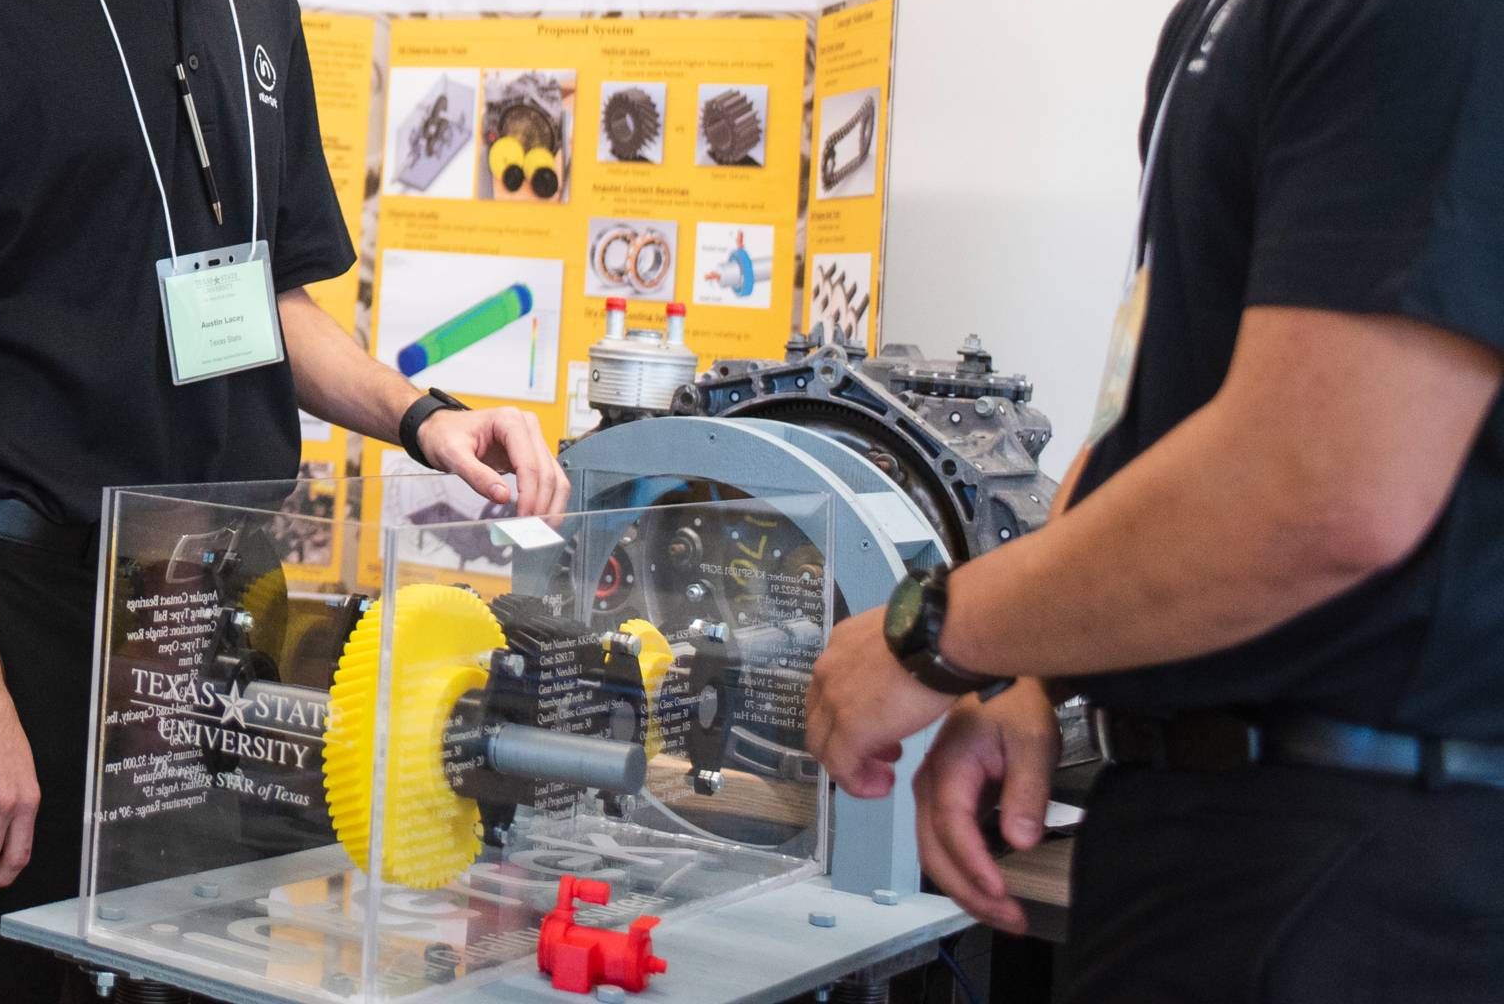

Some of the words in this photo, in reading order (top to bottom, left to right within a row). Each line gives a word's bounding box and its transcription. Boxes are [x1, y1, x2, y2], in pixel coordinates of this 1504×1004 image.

[201, 317, 223, 330] Austin
[224, 314, 245, 326] Lacey
[131, 667, 216, 709] TEXAS
[254, 691, 345, 733] STATE
[160, 717, 311, 770] UNIVERSITY
[216, 772, 254, 795] STAR
[257, 782, 274, 800] of
[274, 784, 311, 806] Texas
